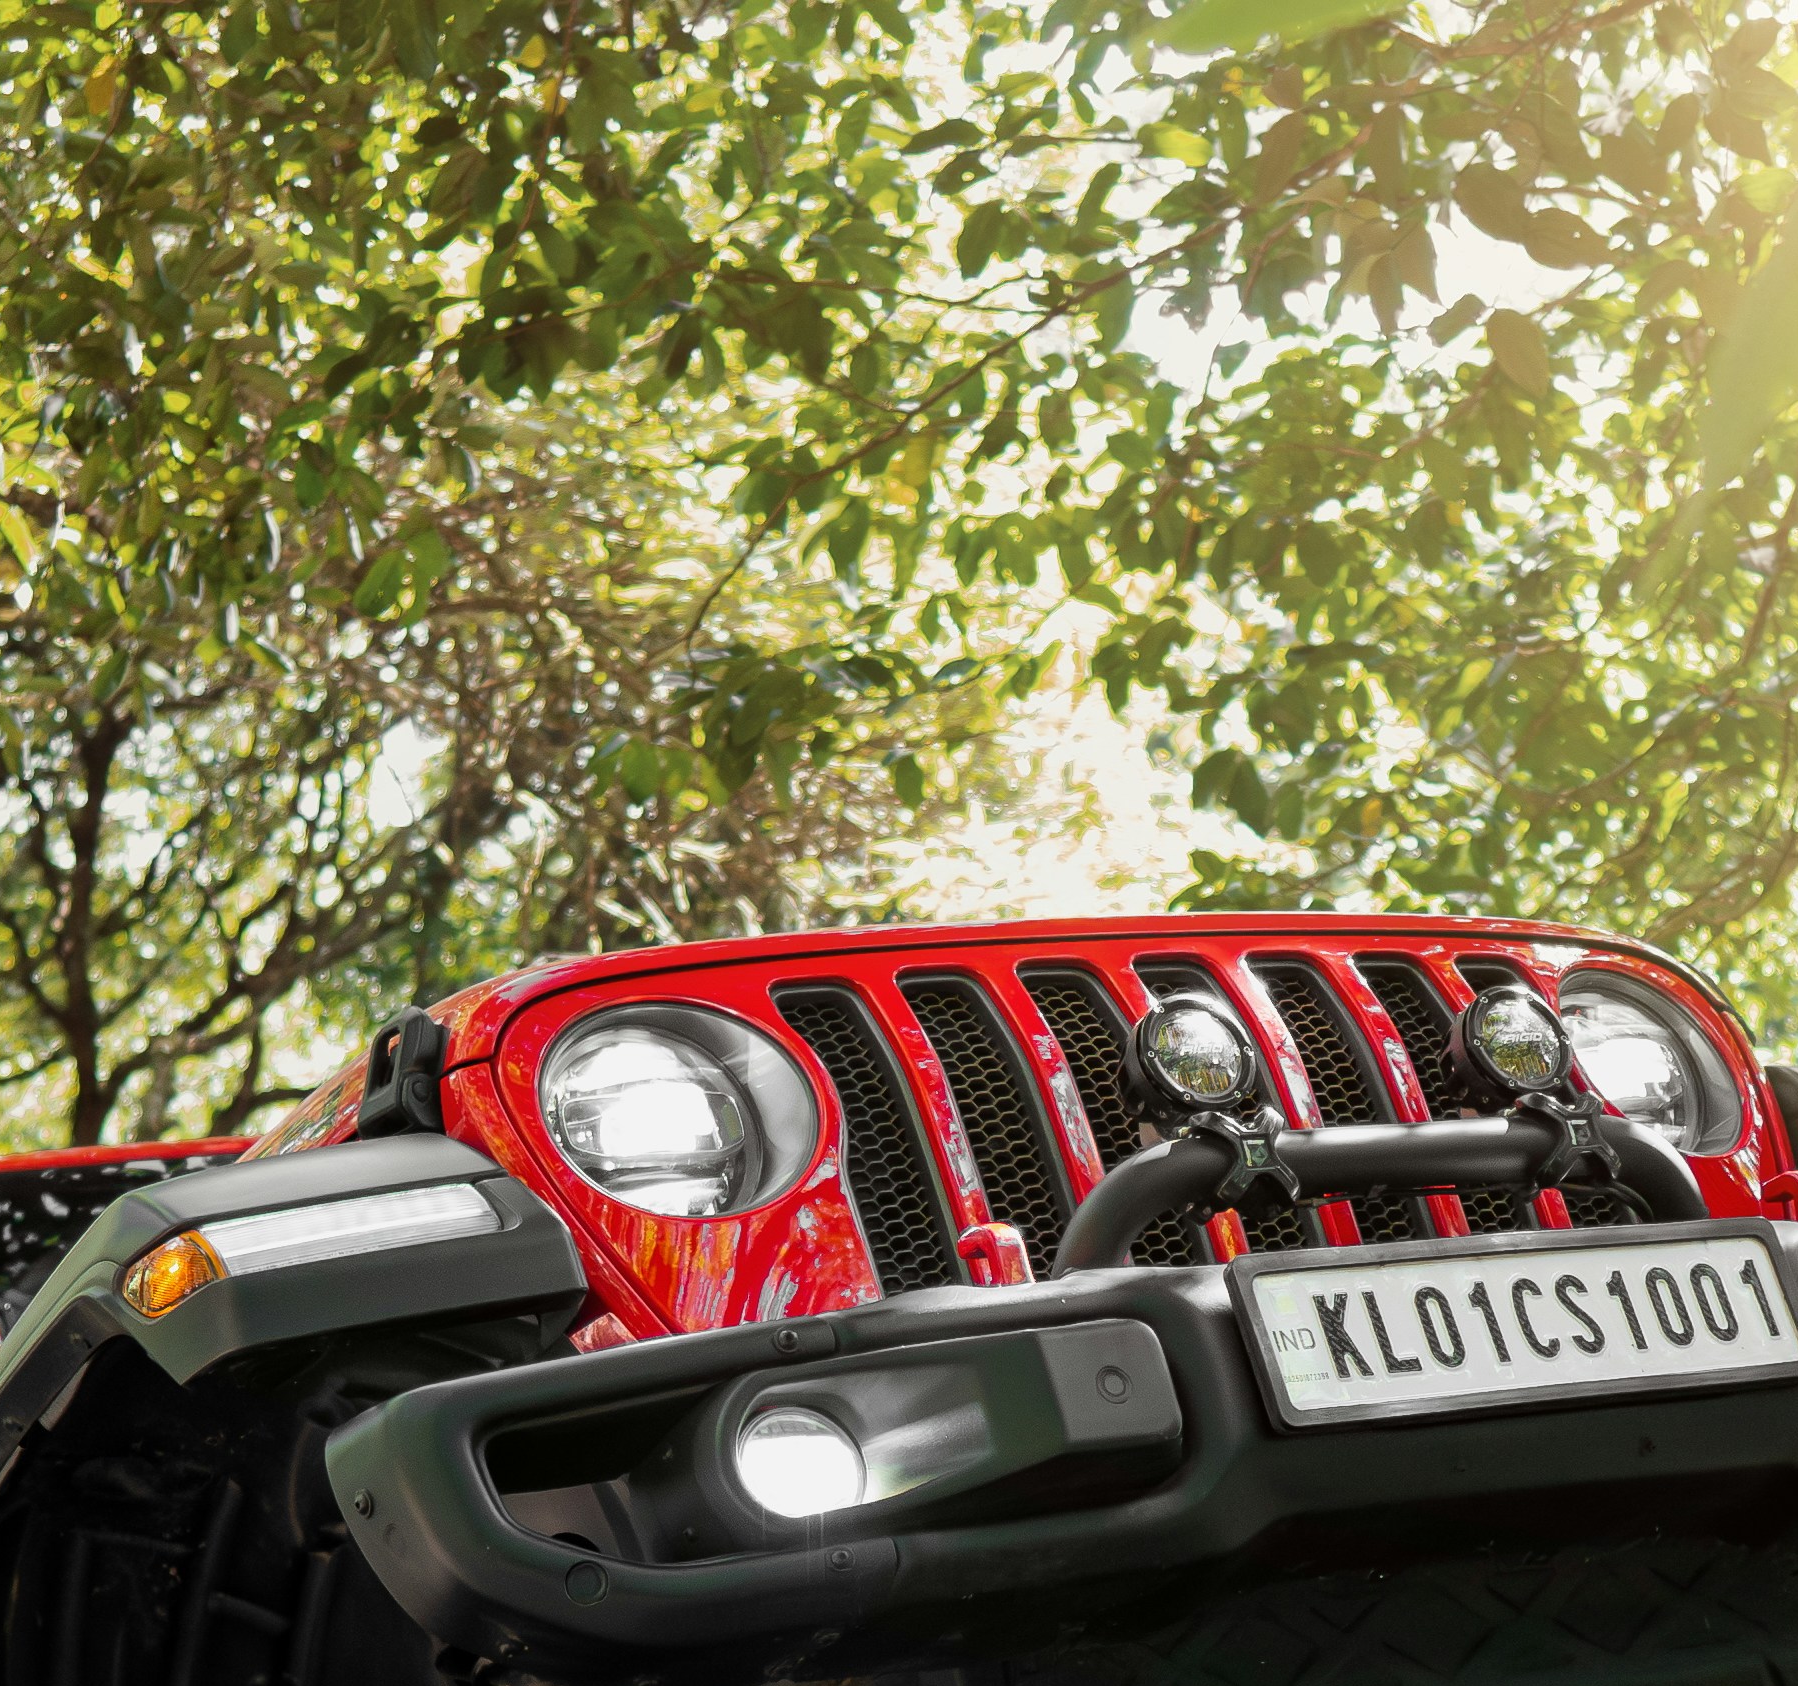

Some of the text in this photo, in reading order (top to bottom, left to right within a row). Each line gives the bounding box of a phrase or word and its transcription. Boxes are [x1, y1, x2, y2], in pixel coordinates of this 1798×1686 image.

[1501, 1032, 1543, 1044] RIGID
[1312, 1259, 1781, 1379] KL01CS1001
[1272, 1328, 1316, 1352] IND
